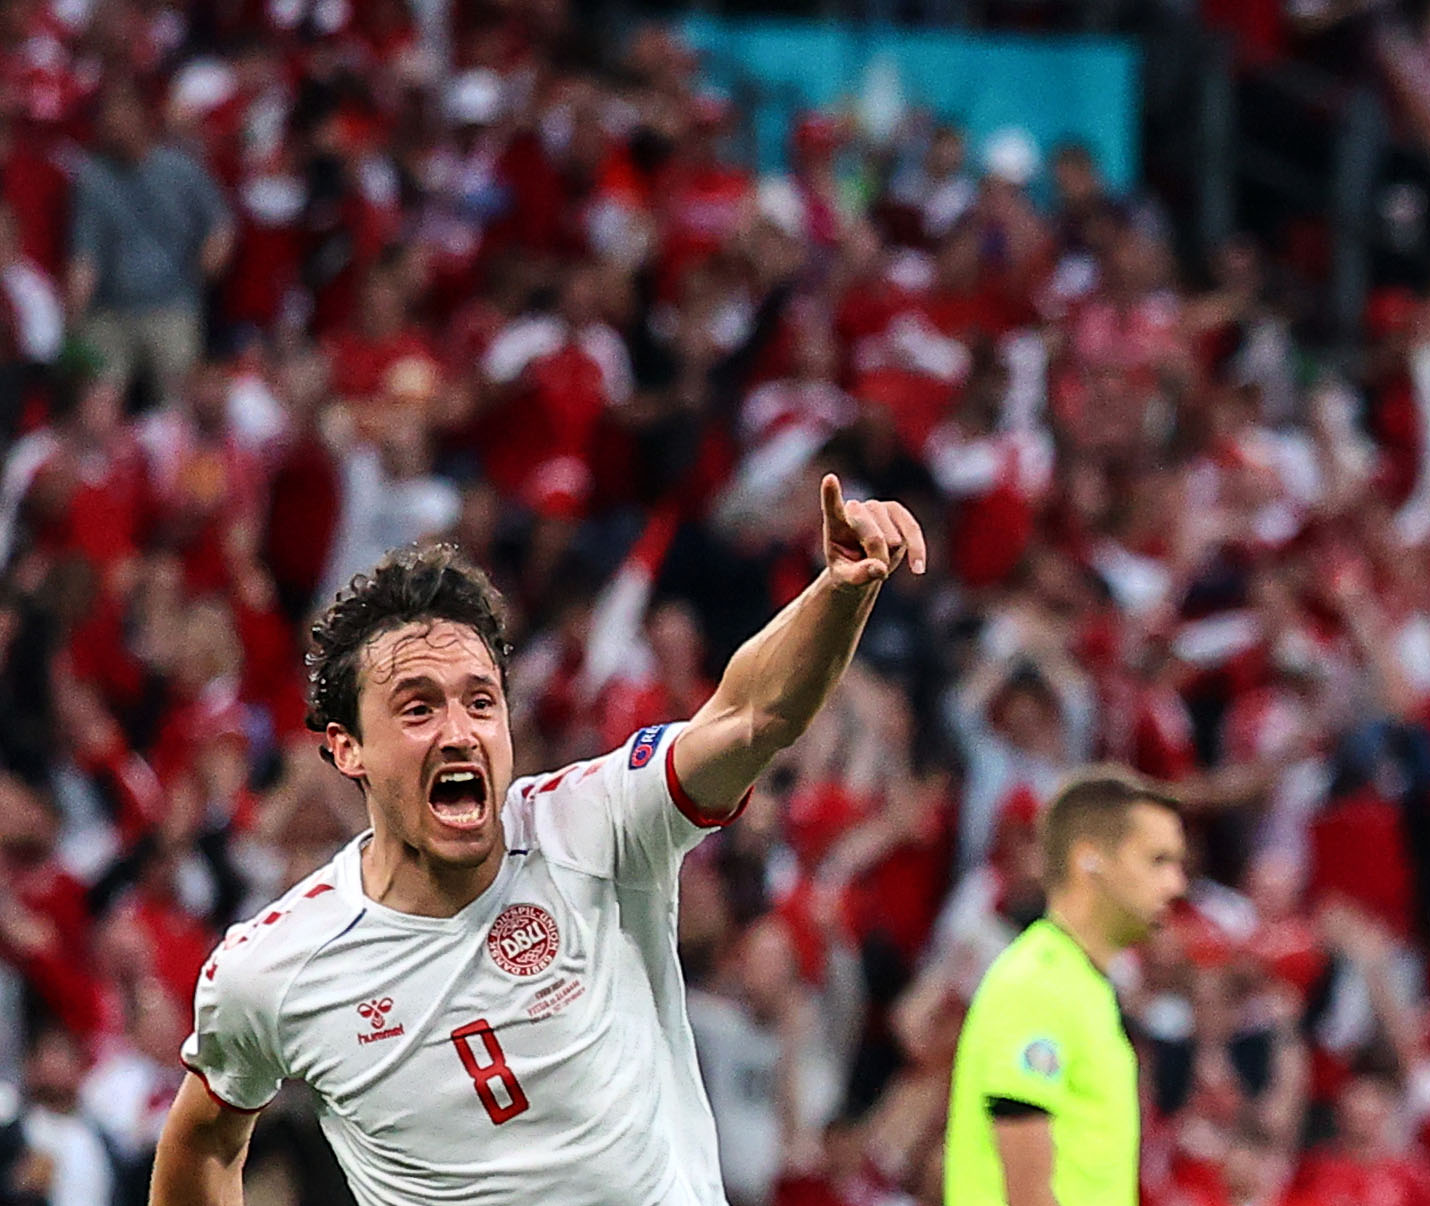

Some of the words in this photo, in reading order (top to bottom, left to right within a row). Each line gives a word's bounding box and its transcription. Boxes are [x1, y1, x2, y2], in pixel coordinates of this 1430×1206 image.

[500, 921, 546, 959] DBU
[357, 1023, 405, 1046] hummel
[451, 1018, 530, 1126] 8
